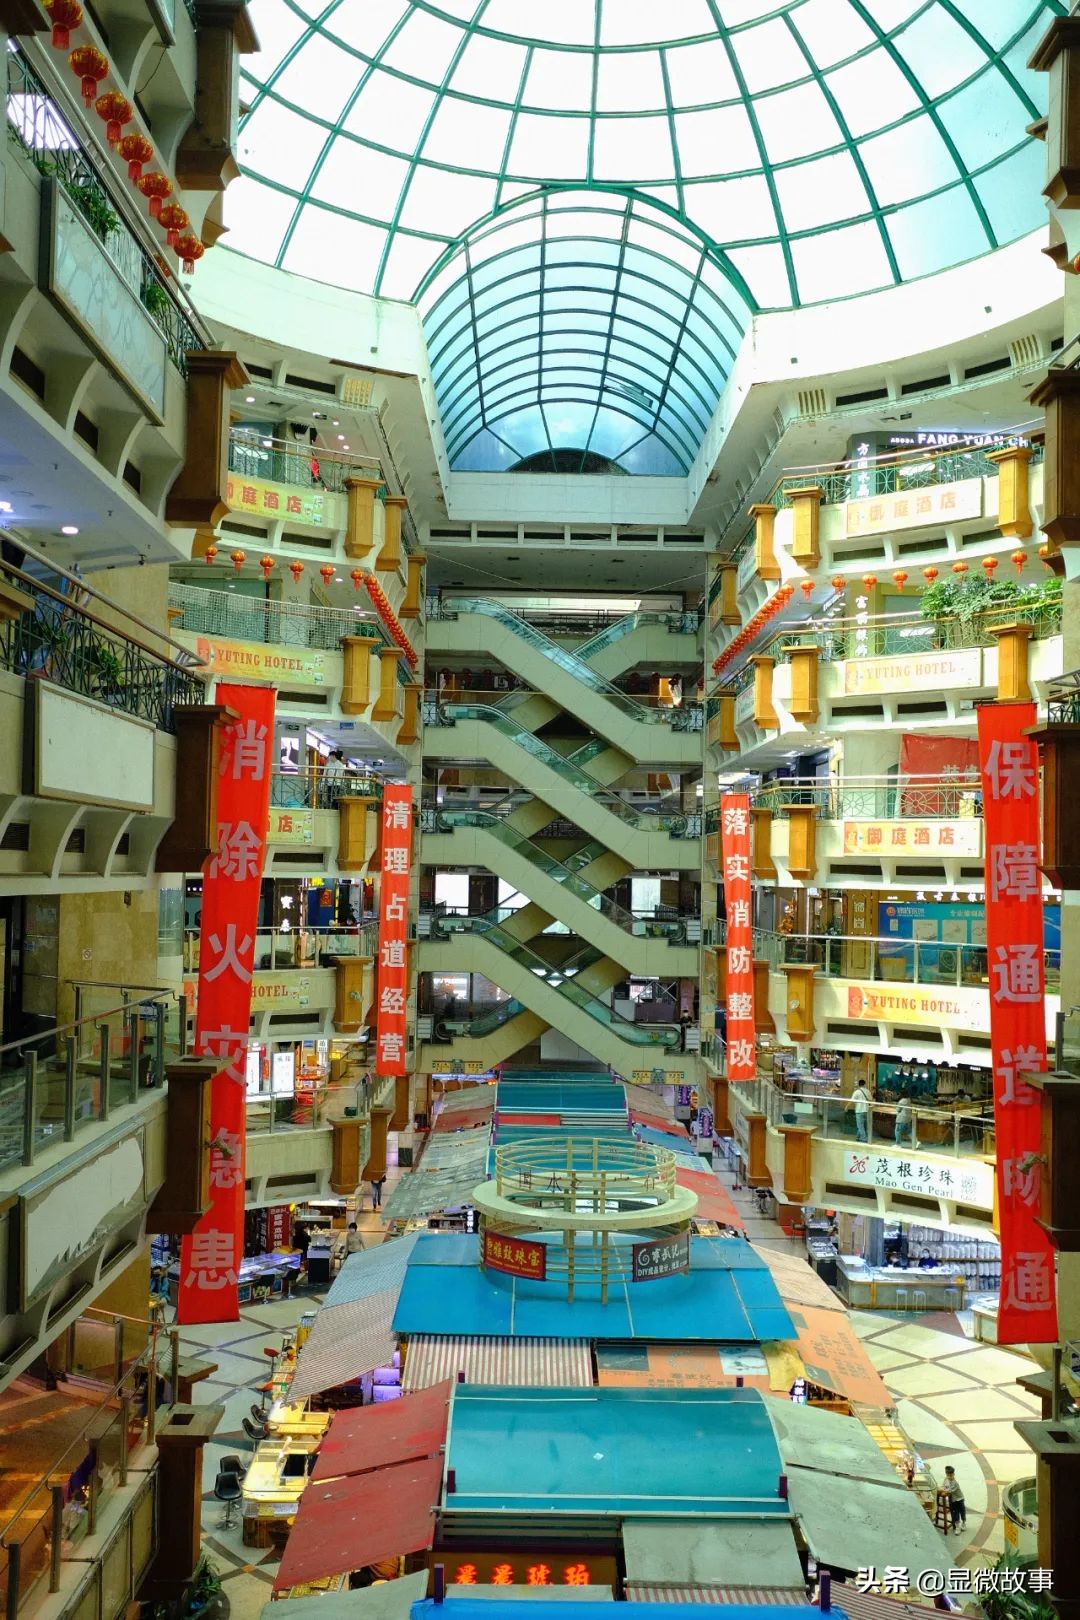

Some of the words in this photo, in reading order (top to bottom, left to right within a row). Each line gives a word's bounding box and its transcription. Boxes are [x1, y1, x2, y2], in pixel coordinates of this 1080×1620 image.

[917, 433, 958, 446] FANG
[217, 649, 260, 667] YUTING
[264, 656, 303, 671] HOTEL
[865, 664, 911, 680] YUTING
[915, 661, 956, 676] HOTEL
[867, 827, 955, 846] 御庭酒店
[380, 800, 411, 1062] 清理占道经营
[723, 807, 754, 1069] 落实消防整改
[871, 995, 917, 1011] YUTING
[920, 999, 961, 1015] HOTEL
[875, 1157, 955, 1187] 茂根珍珠
[875, 1176, 897, 1188] Mao
[902, 1180, 923, 1193] Gen
[928, 1184, 954, 1199] Pearl
